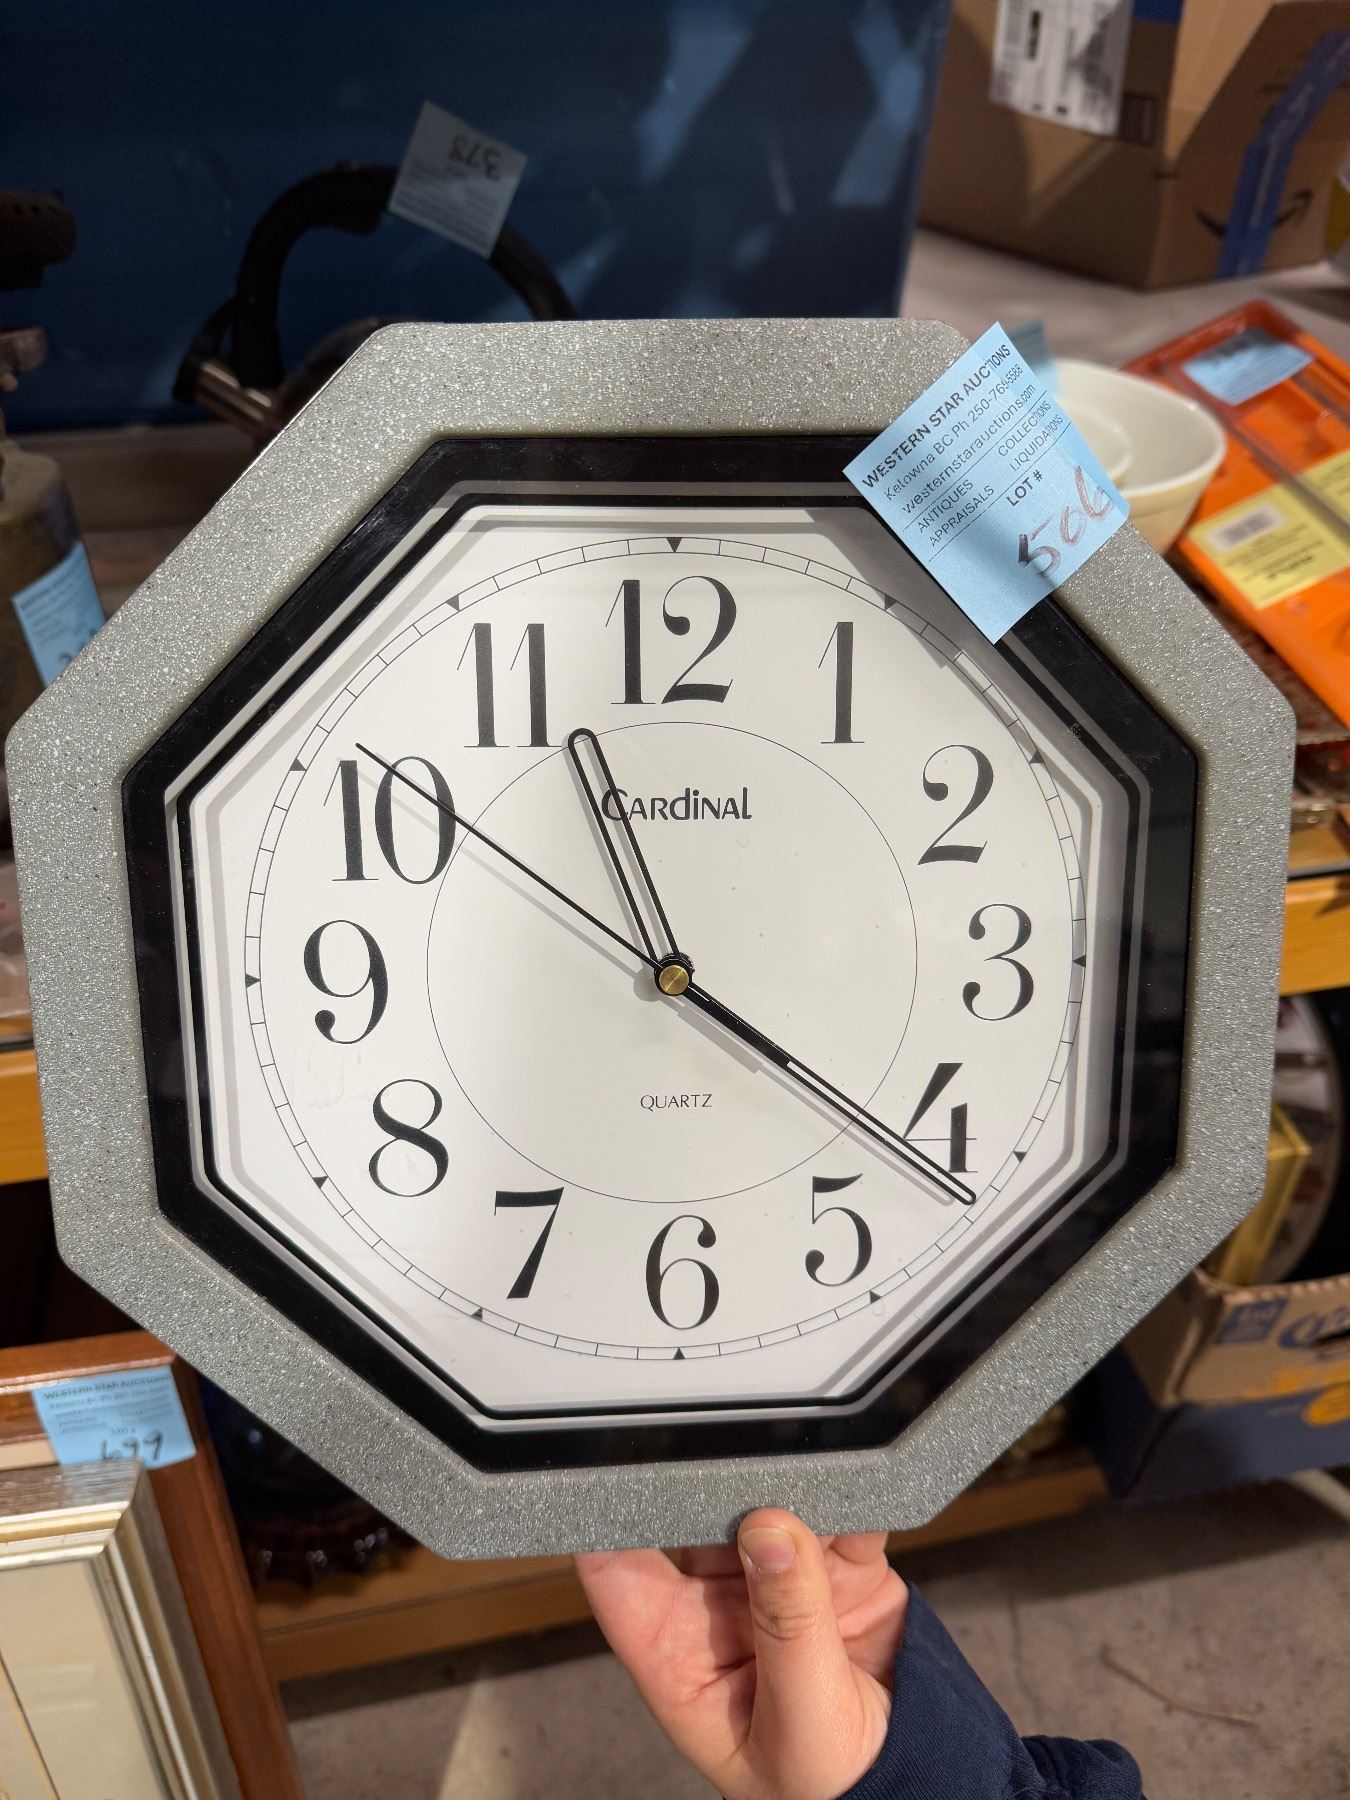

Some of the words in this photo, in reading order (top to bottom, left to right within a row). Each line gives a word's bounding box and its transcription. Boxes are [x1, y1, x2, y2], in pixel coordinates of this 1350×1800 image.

[862, 424, 931, 488] WESTERN
[929, 392, 964, 427] STAR
[963, 345, 1010, 396] AUCTIONS
[884, 454, 935, 501] Kelowna
[933, 434, 953, 455] BC
[951, 421, 969, 438] Ph
[968, 364, 1023, 423] 250-769-5588
[902, 385, 1036, 513] westernstarauctions.com
[998, 401, 1051, 456] COLLECTIONS
[1010, 414, 1064, 471] LIQUIDATIONS
[918, 480, 973, 533] ANTIQUES
[930, 486, 994, 547] APPRAISALS
[1006, 477, 1033, 507] LOT
[1017, 464, 1112, 577] 506
[457, 622, 562, 748] 11
[605, 576, 738, 705] 12
[818, 622, 865, 745] 1
[323, 756, 456, 885] 10
[917, 745, 994, 865] 2
[304, 920, 389, 1044] 9
[962, 903, 1034, 1021] 3
[369, 1079, 449, 1197] 8
[640, 1093, 712, 1112] QUARTZ
[902, 1063, 978, 1174] 4
[494, 1187, 564, 1299] 7
[645, 1214, 720, 1331] 6
[805, 1173, 873, 1287] 5
